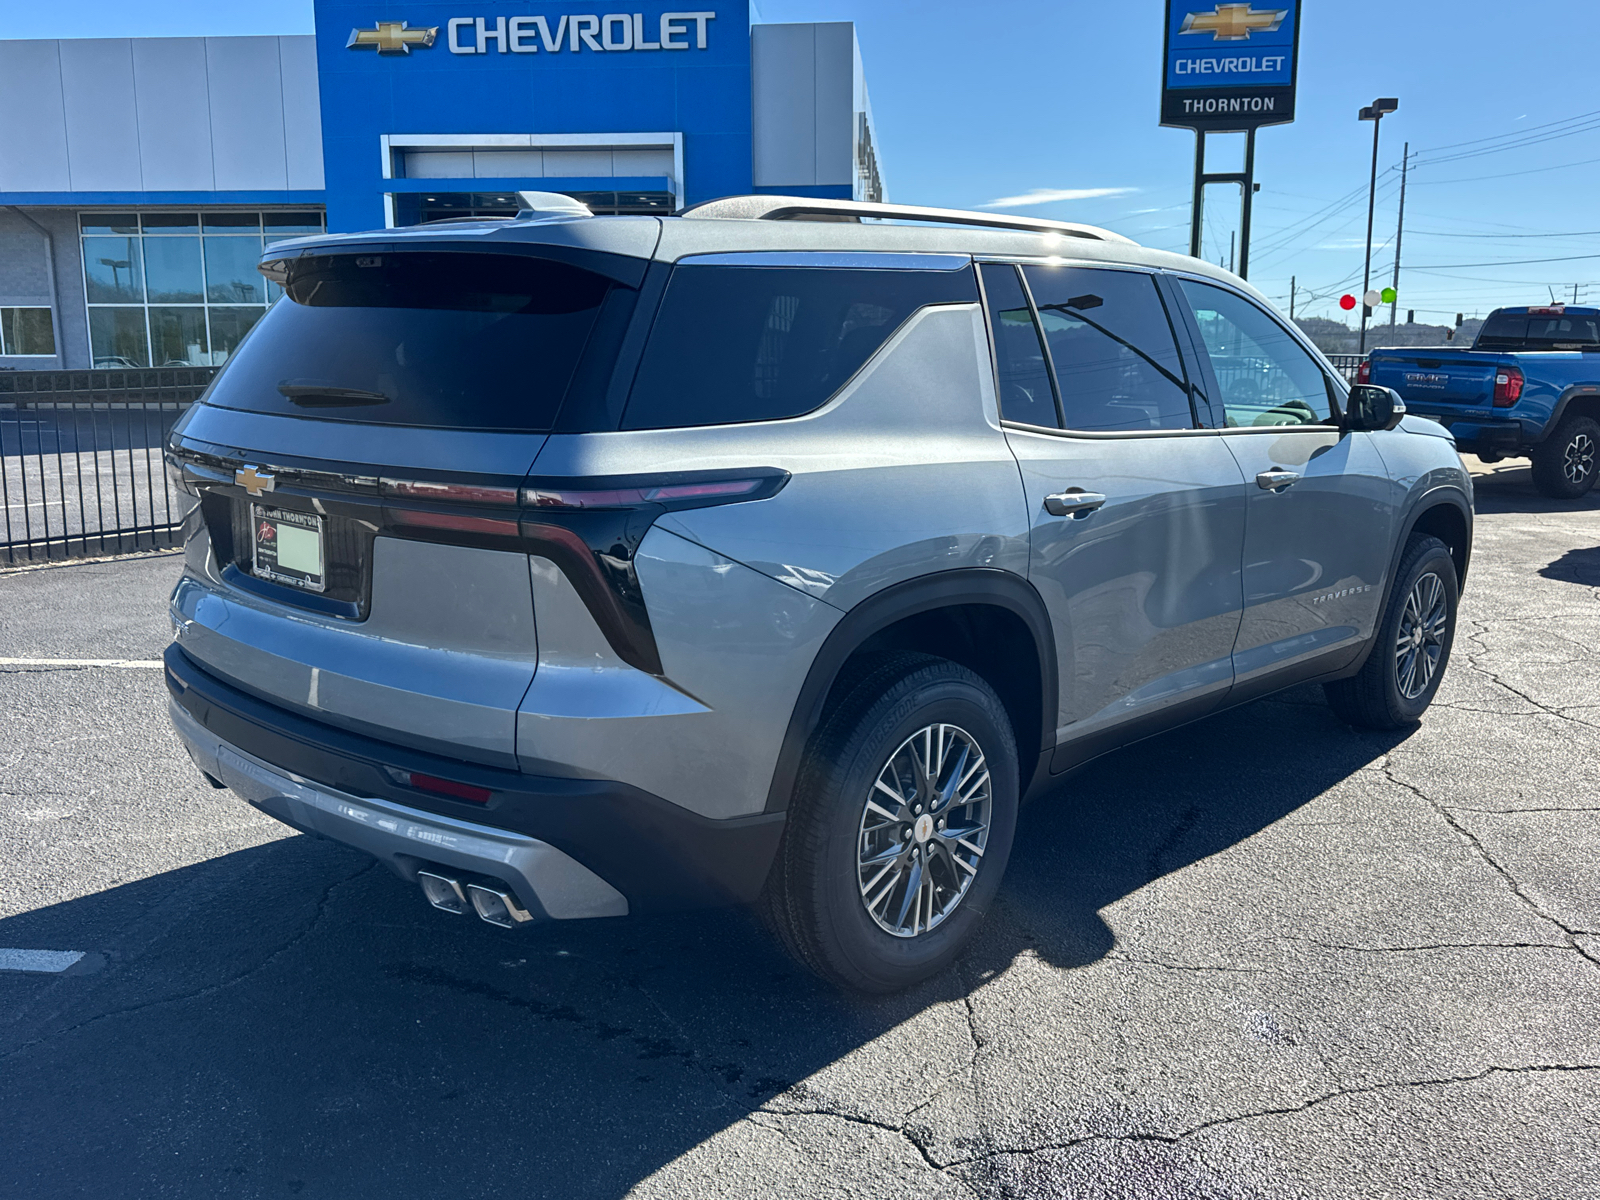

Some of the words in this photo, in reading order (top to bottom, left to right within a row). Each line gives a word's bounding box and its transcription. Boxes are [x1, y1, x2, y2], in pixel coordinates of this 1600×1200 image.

[447, 11, 716, 54] CHEVROLET
[1175, 56, 1286, 75] CHEVROLET
[1183, 97, 1275, 113] THORNTON
[1405, 373, 1449, 385] GMC
[282, 511, 317, 527] THORNTON
[1312, 584, 1372, 605] TRAVERSE
